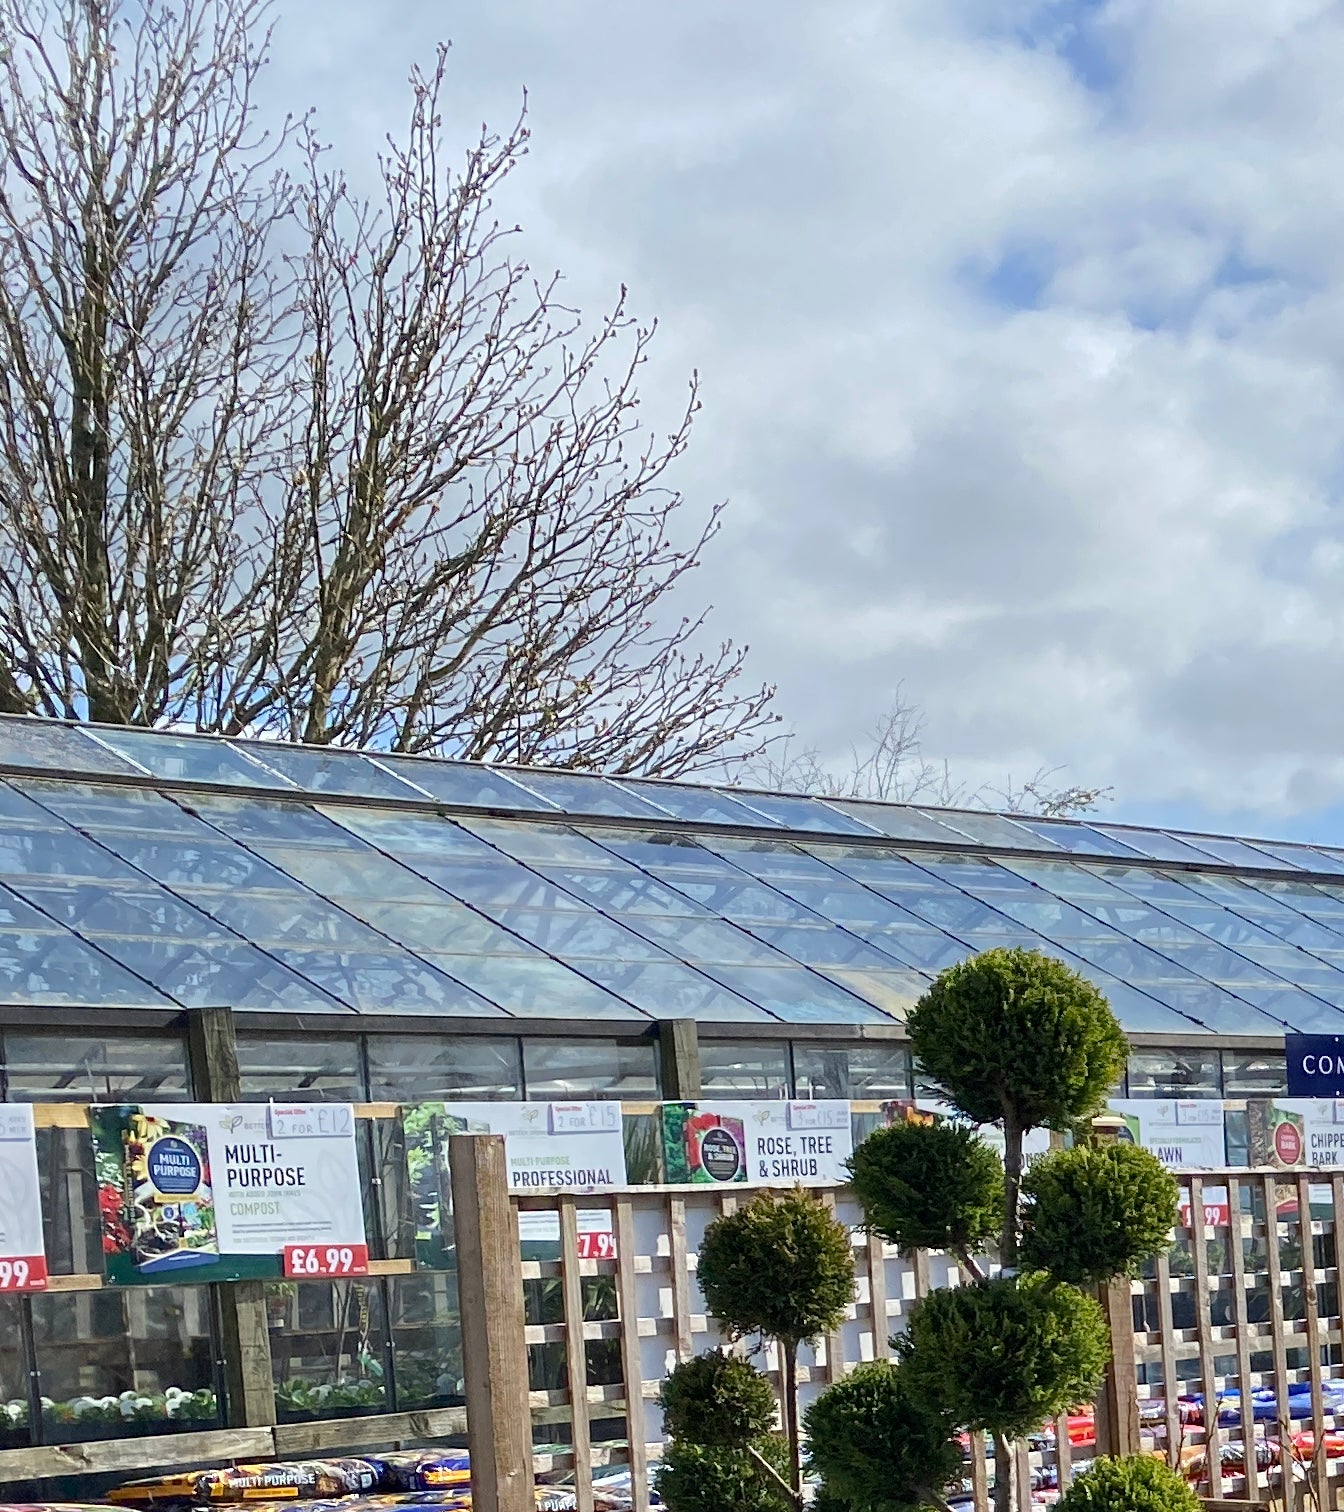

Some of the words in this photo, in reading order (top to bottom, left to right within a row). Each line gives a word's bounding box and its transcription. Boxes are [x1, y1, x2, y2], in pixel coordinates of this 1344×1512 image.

[277, 1120, 285, 1134] 2
[318, 1108, 350, 1133] £12
[569, 1117, 586, 1127] FOR
[225, 1144, 282, 1164] MULTI-
[757, 1137, 796, 1157] ROSE,
[800, 1136, 833, 1154] TREE
[160, 1153, 190, 1165] MULTI
[511, 1157, 533, 1166] MULTI
[535, 1156, 570, 1166] PURPOSE
[1312, 1152, 1338, 1165] BARK
[154, 1164, 197, 1178] PURPOSE
[759, 1160, 769, 1177] &
[772, 1159, 817, 1177] SHRUB
[227, 1167, 306, 1187] PURPOSE
[513, 1169, 614, 1187] PROFESSIONAL
[230, 1202, 280, 1216] COMPOST
[291, 1248, 354, 1274] £6.99
[229, 1476, 262, 1489] MULTI
[264, 1473, 316, 1487] PURPOSE
